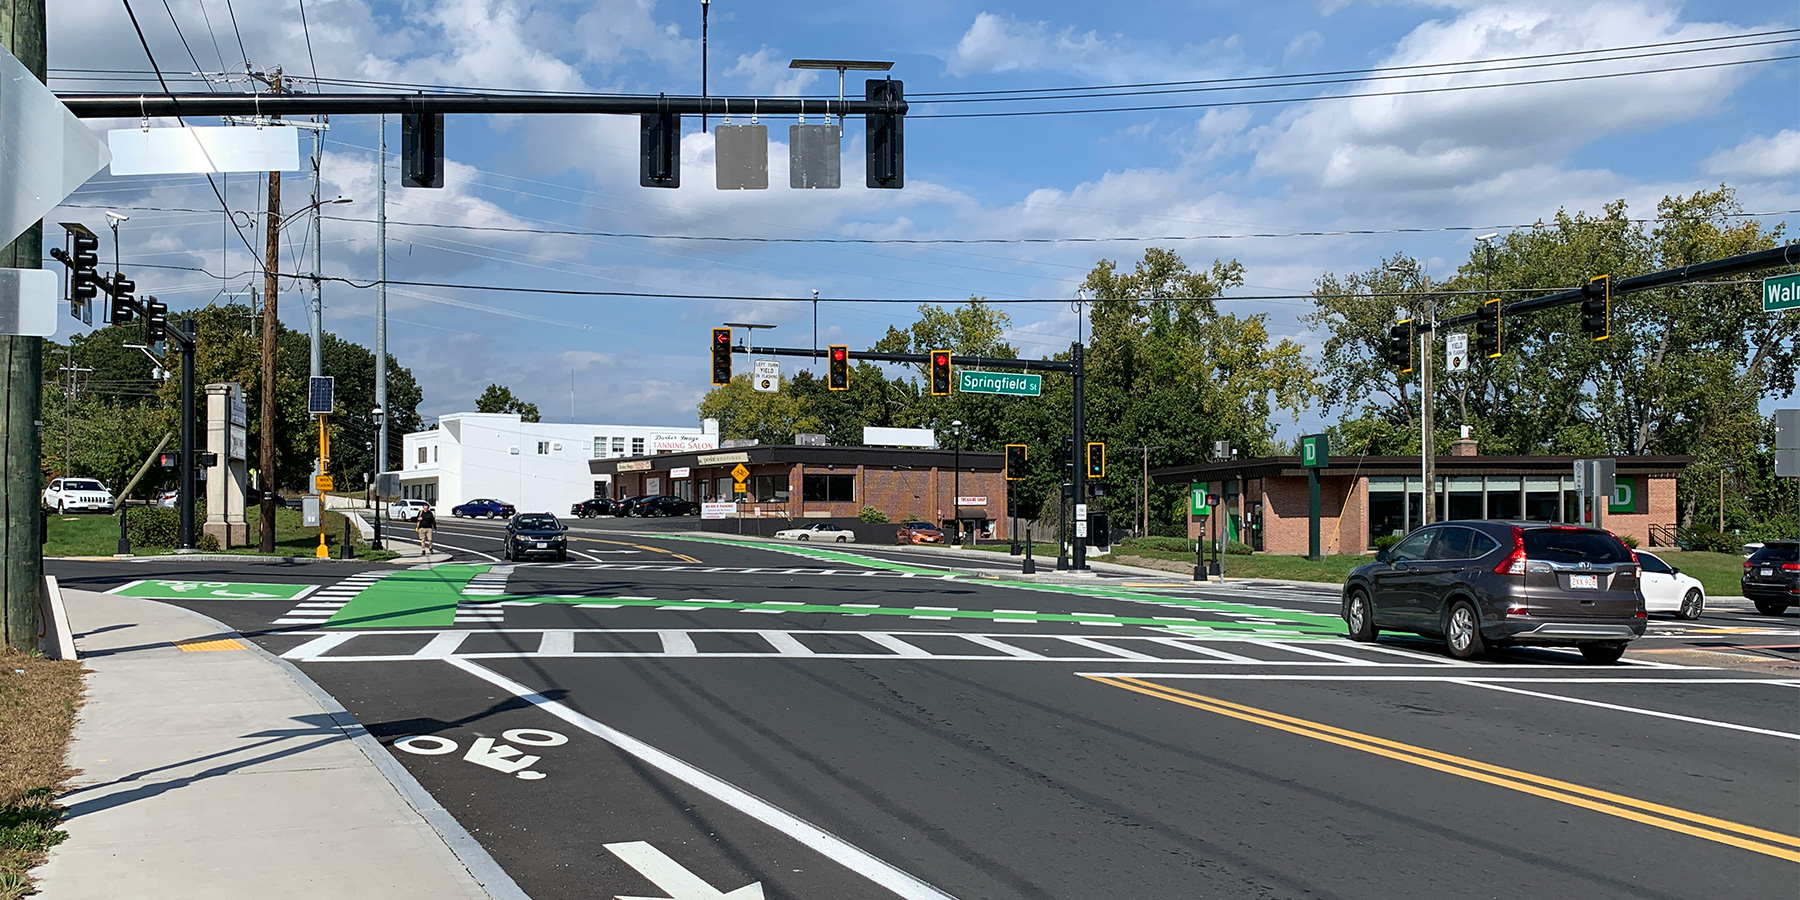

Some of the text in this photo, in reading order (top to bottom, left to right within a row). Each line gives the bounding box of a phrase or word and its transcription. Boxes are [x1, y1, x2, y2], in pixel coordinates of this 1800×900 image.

[964, 374, 1037, 392] Springfield St
[1304, 443, 1315, 460] TD
[1193, 488, 1206, 509] TD
